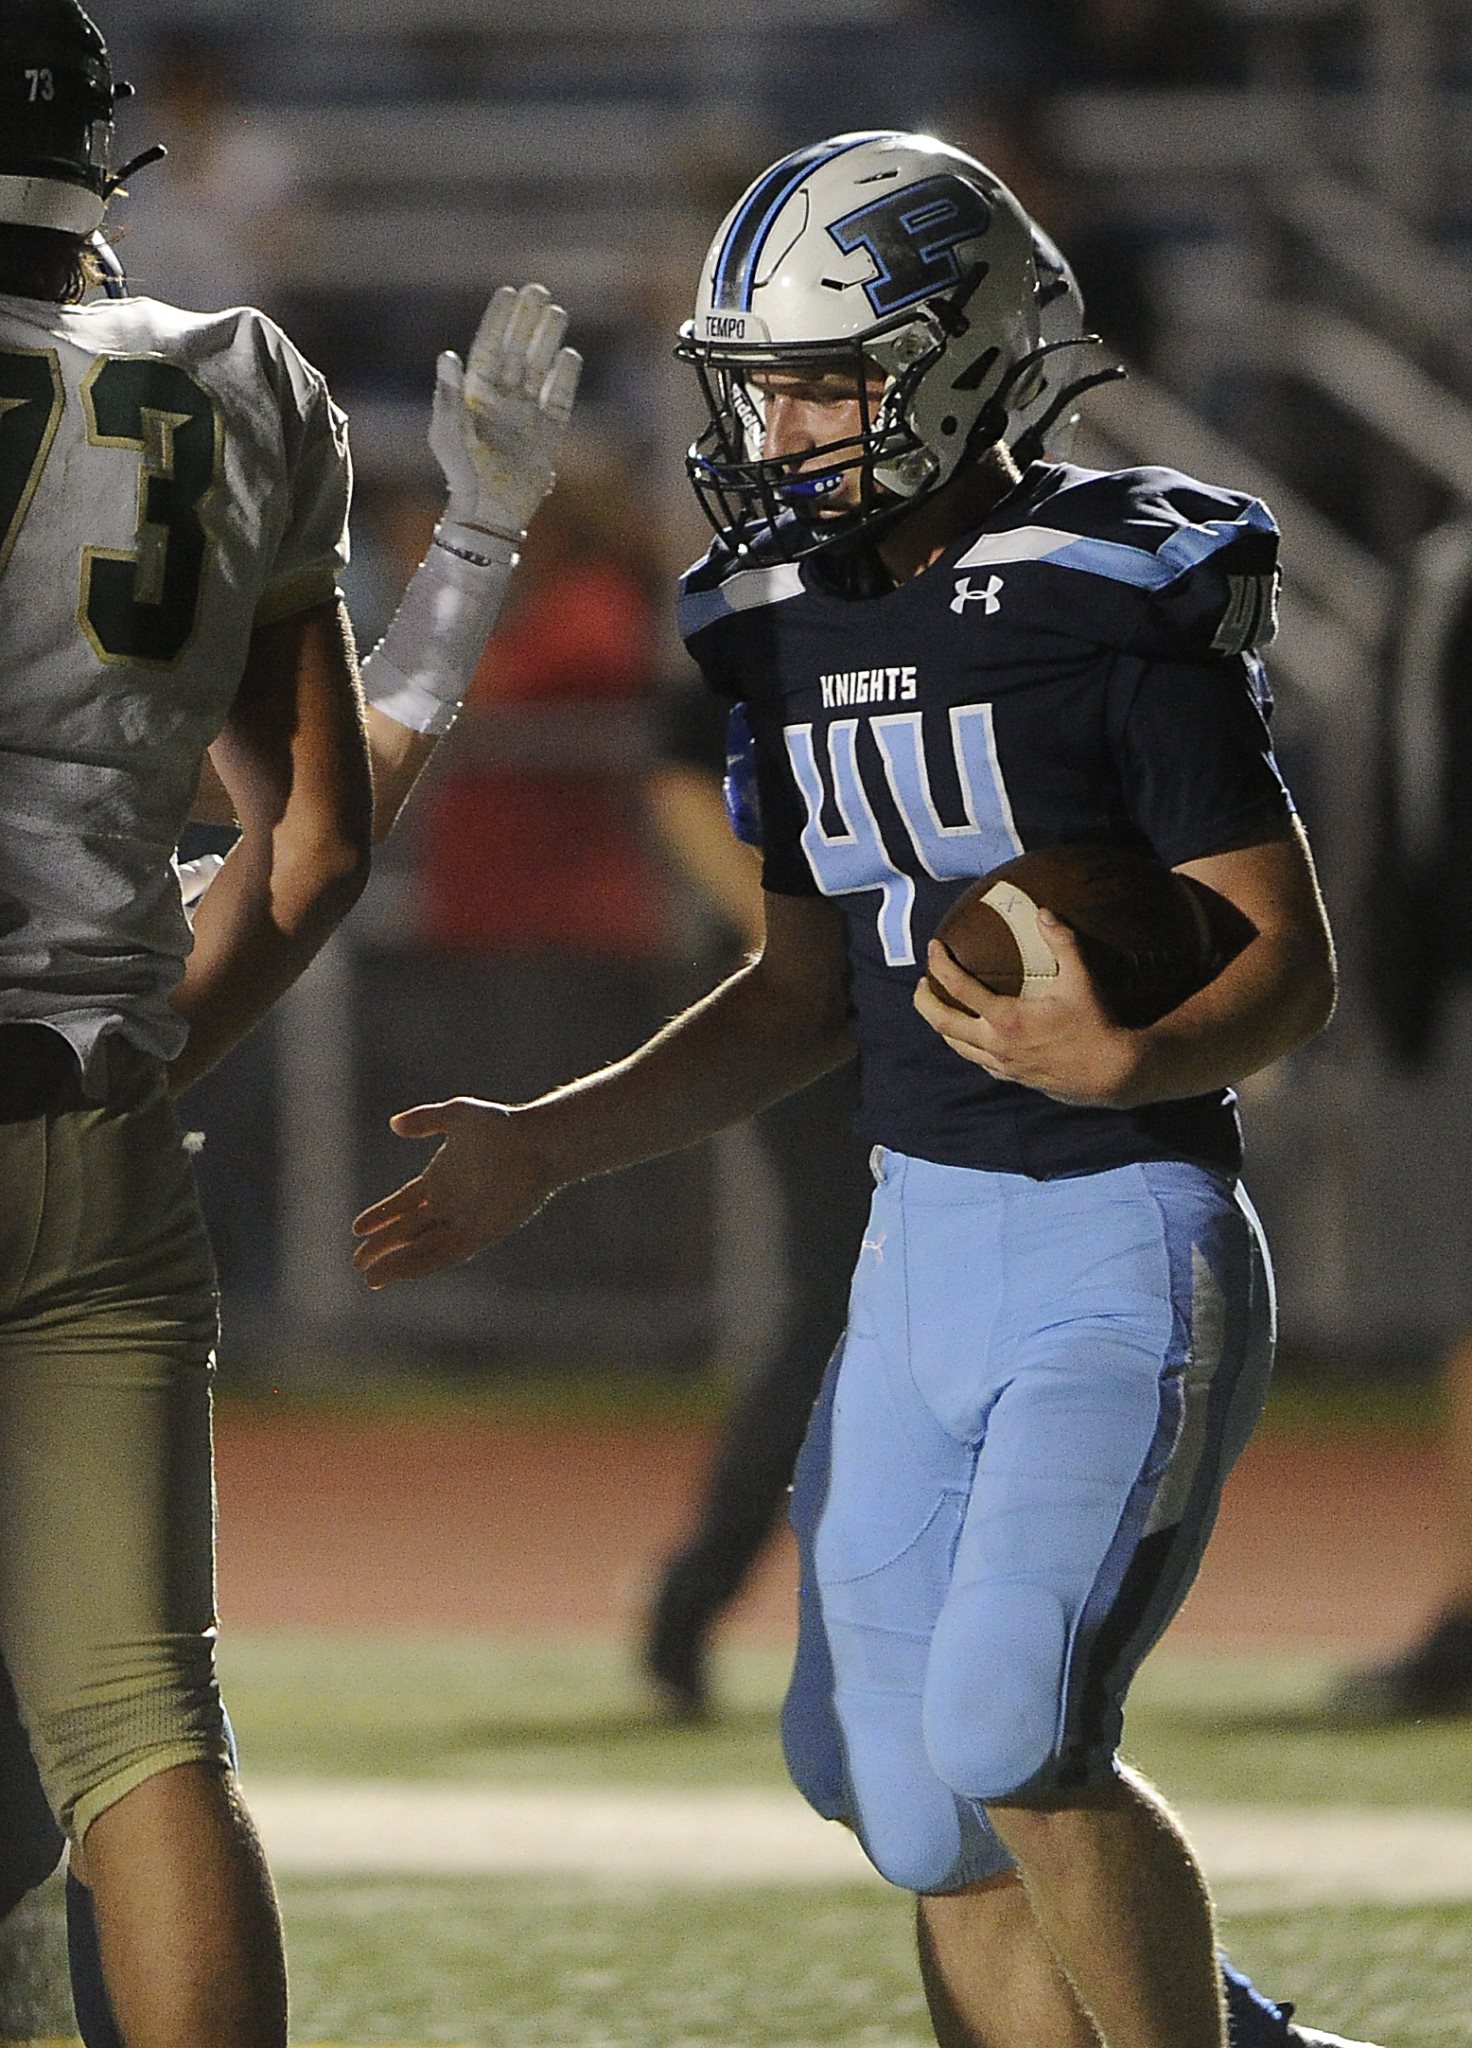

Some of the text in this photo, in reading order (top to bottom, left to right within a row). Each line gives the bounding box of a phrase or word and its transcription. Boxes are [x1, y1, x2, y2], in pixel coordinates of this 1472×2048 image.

[25, 69, 54, 101] 73
[706, 316, 745, 339] TEMPO
[820, 666, 917, 709] KNIGHTS
[784, 702, 1025, 967] 44
